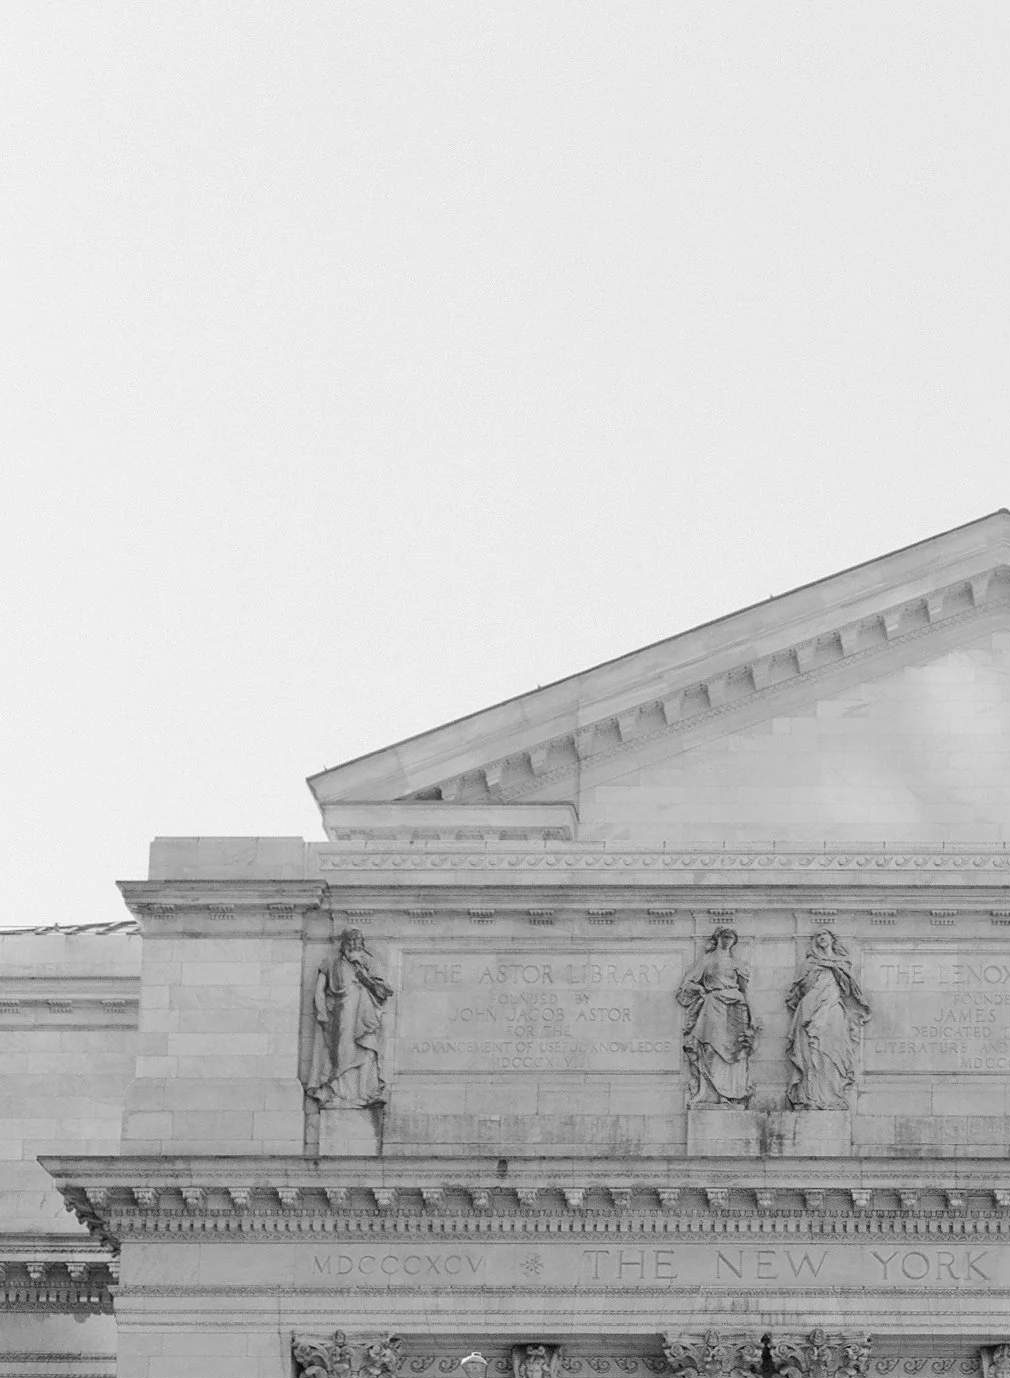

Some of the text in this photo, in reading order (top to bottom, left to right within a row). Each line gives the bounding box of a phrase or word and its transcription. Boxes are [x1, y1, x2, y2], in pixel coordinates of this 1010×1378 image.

[419, 963, 667, 985] THE ASTOR LIBRARY
[880, 964, 923, 984] THE
[575, 993, 592, 1005] BY
[448, 1008, 632, 1022] JOHN JACOB ASTOR
[934, 1009, 997, 1023] JAMES
[506, 1025, 572, 1037] FOR THE
[912, 1026, 991, 1038] DEDICATED
[411, 1041, 672, 1053] ADVANCEMENT OF USEFUL KNOWLEDGE
[875, 1042, 968, 1054] LITERATURE
[981, 1042, 1008, 1054] AND
[312, 1255, 483, 1276] MDCCCXCV
[584, 1250, 679, 1279] THE
[715, 1250, 829, 1279] NEW
[873, 1250, 993, 1281] YORK
